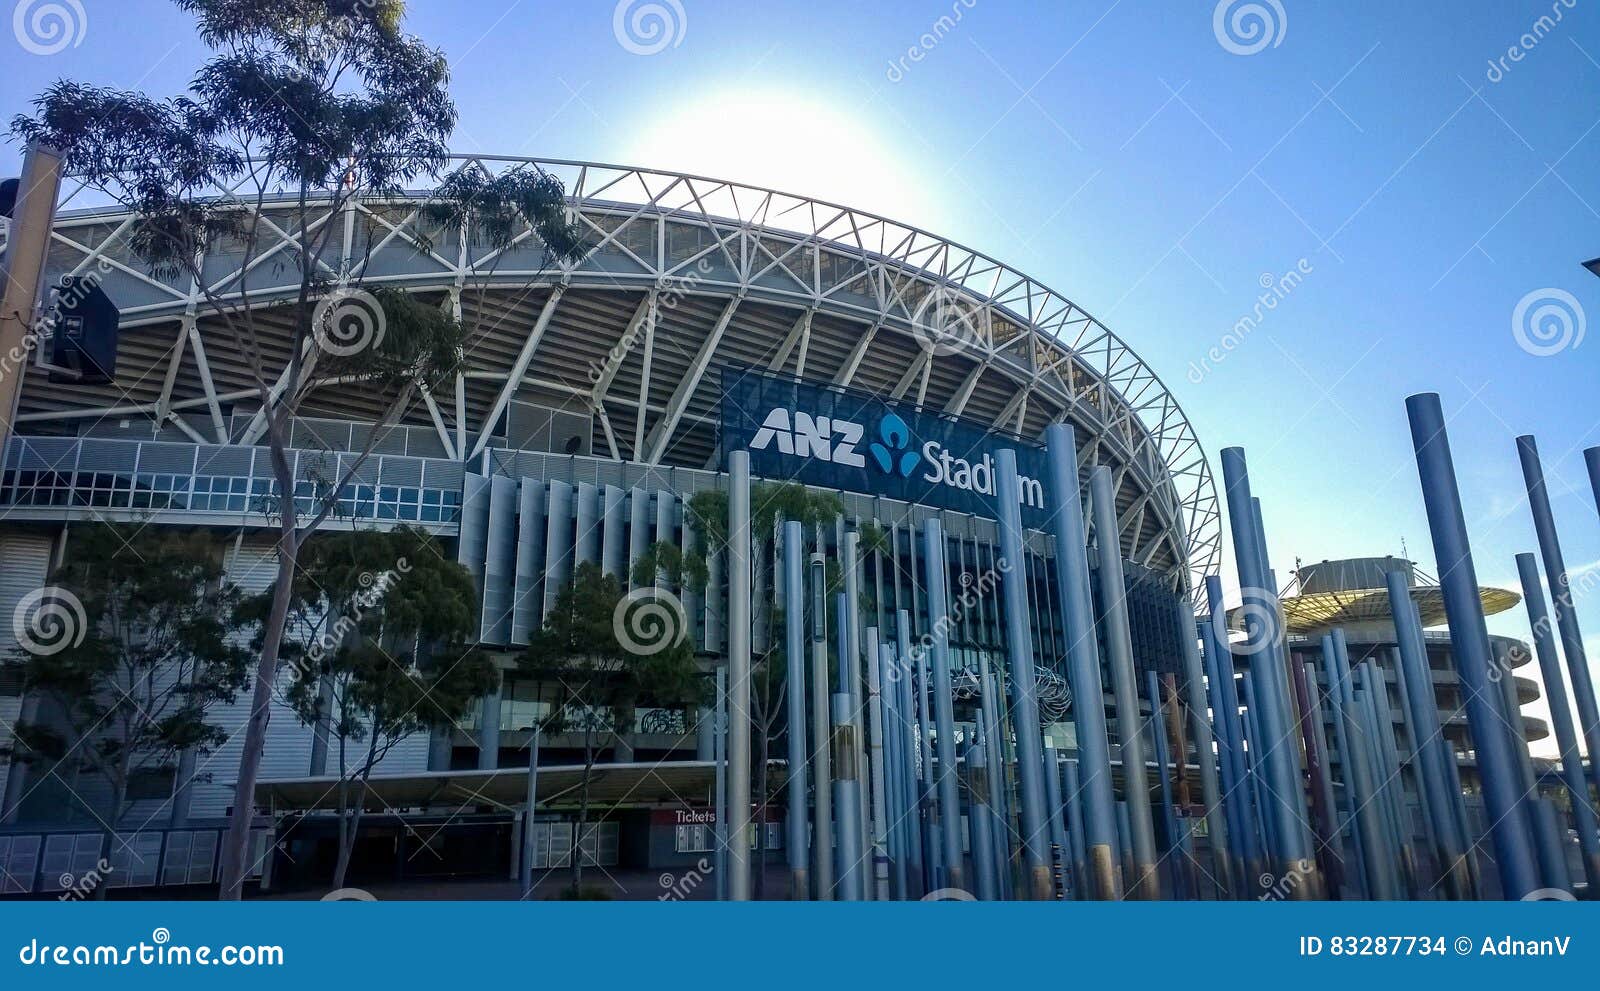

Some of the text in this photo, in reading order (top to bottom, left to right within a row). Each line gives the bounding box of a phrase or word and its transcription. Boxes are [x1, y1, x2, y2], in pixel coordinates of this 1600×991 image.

[750, 407, 1044, 509] ANZ Stadim
[675, 810, 716, 823] Tickets
